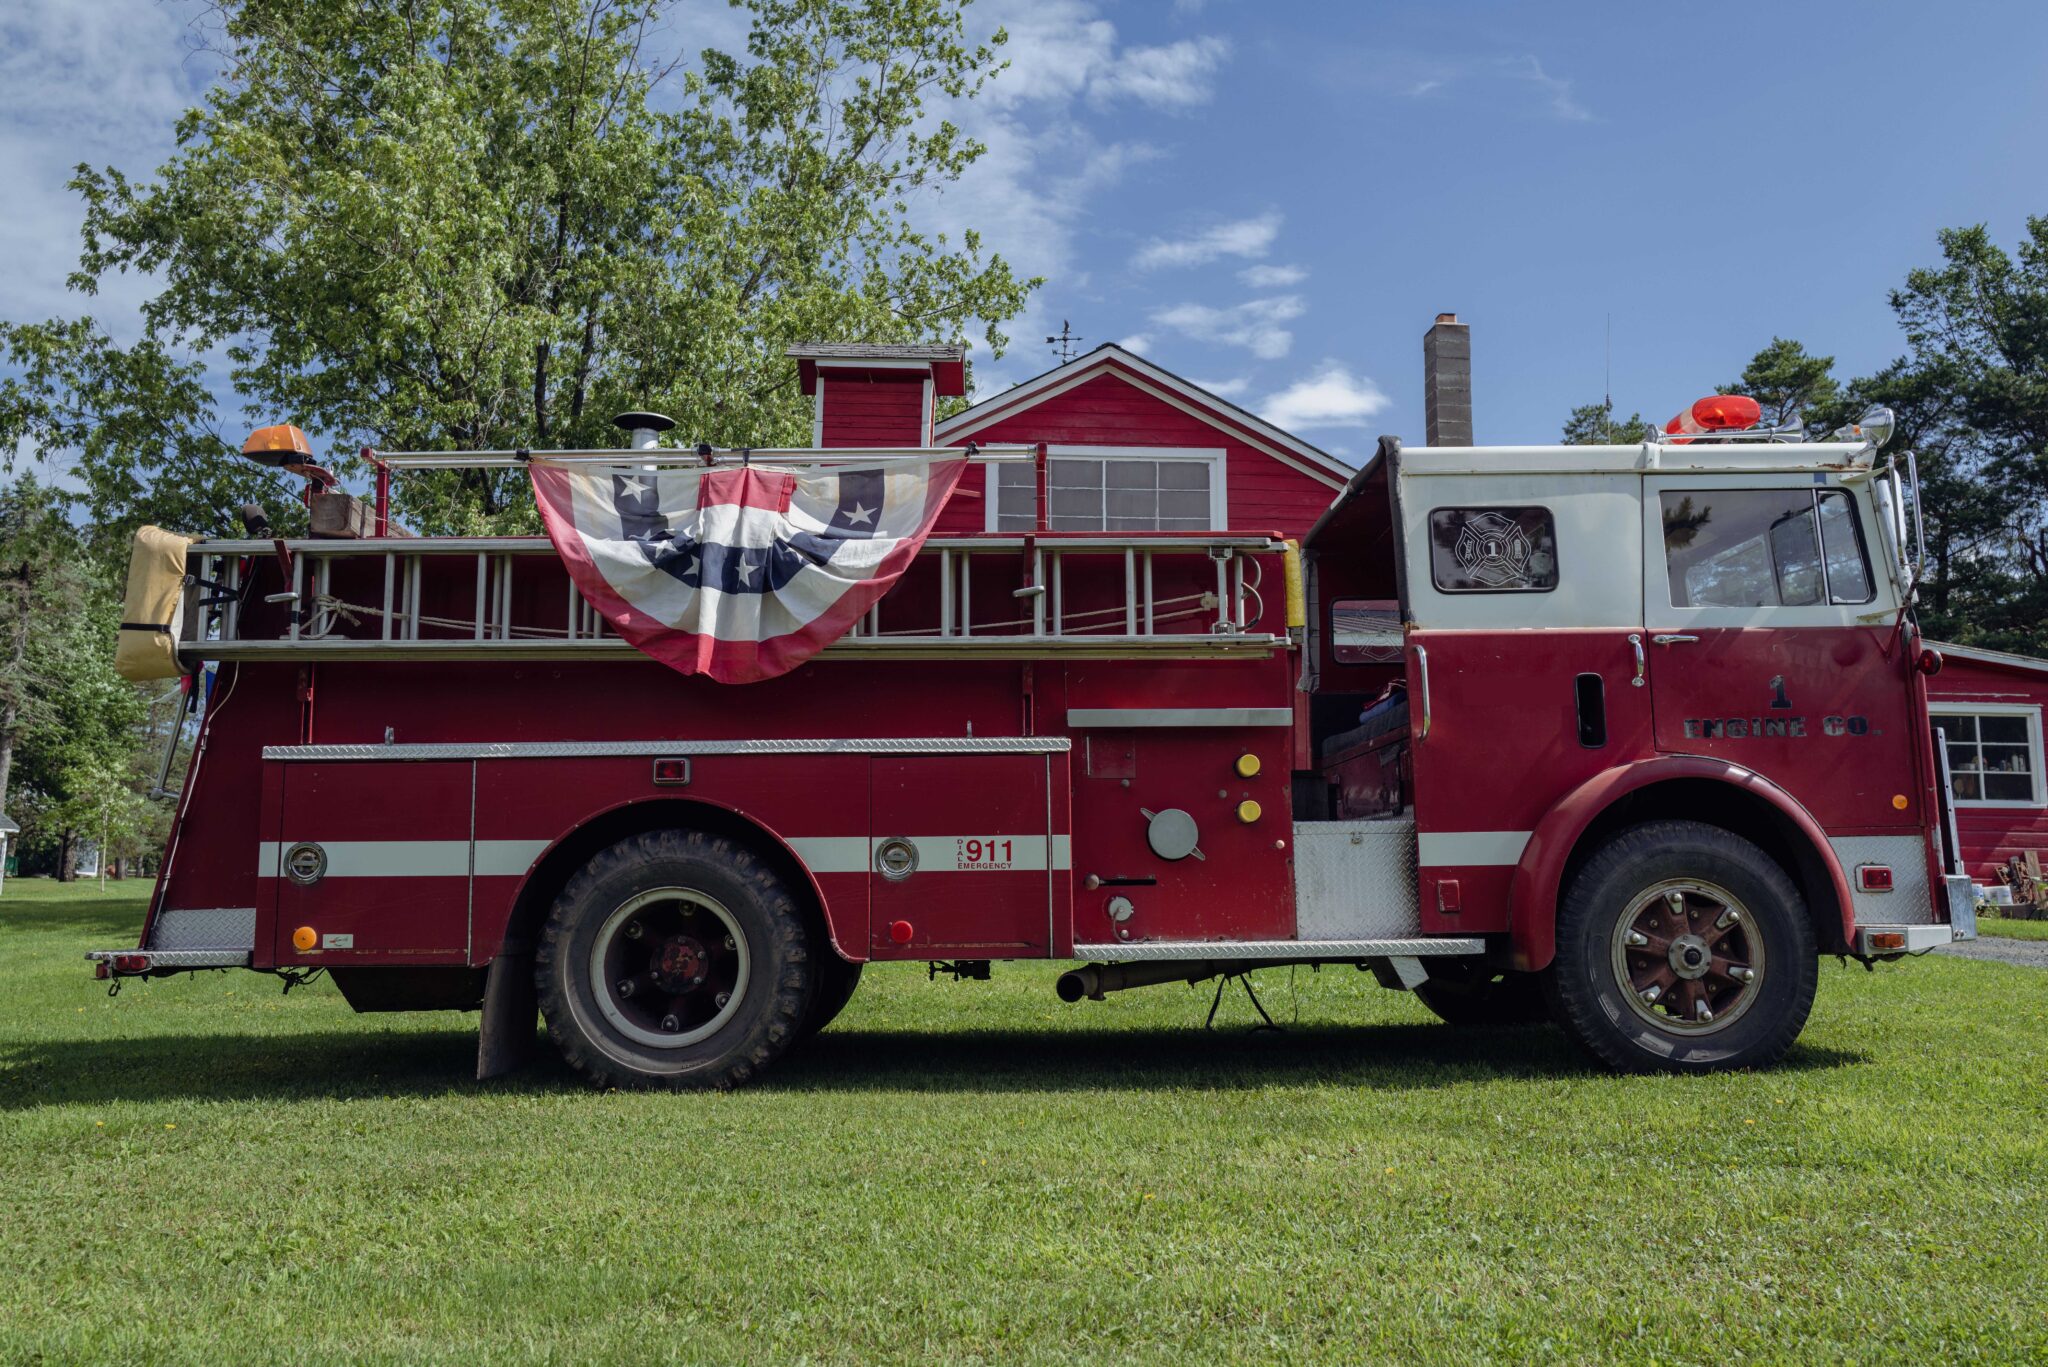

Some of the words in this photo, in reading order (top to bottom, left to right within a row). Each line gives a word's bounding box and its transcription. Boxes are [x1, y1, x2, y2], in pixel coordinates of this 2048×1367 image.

[1487, 541, 1499, 557] 1
[1769, 674, 1793, 710] 1
[1683, 716, 1808, 739] ENGINE
[966, 839, 1012, 862] 911
[957, 862, 1013, 870] EMERGENCY
